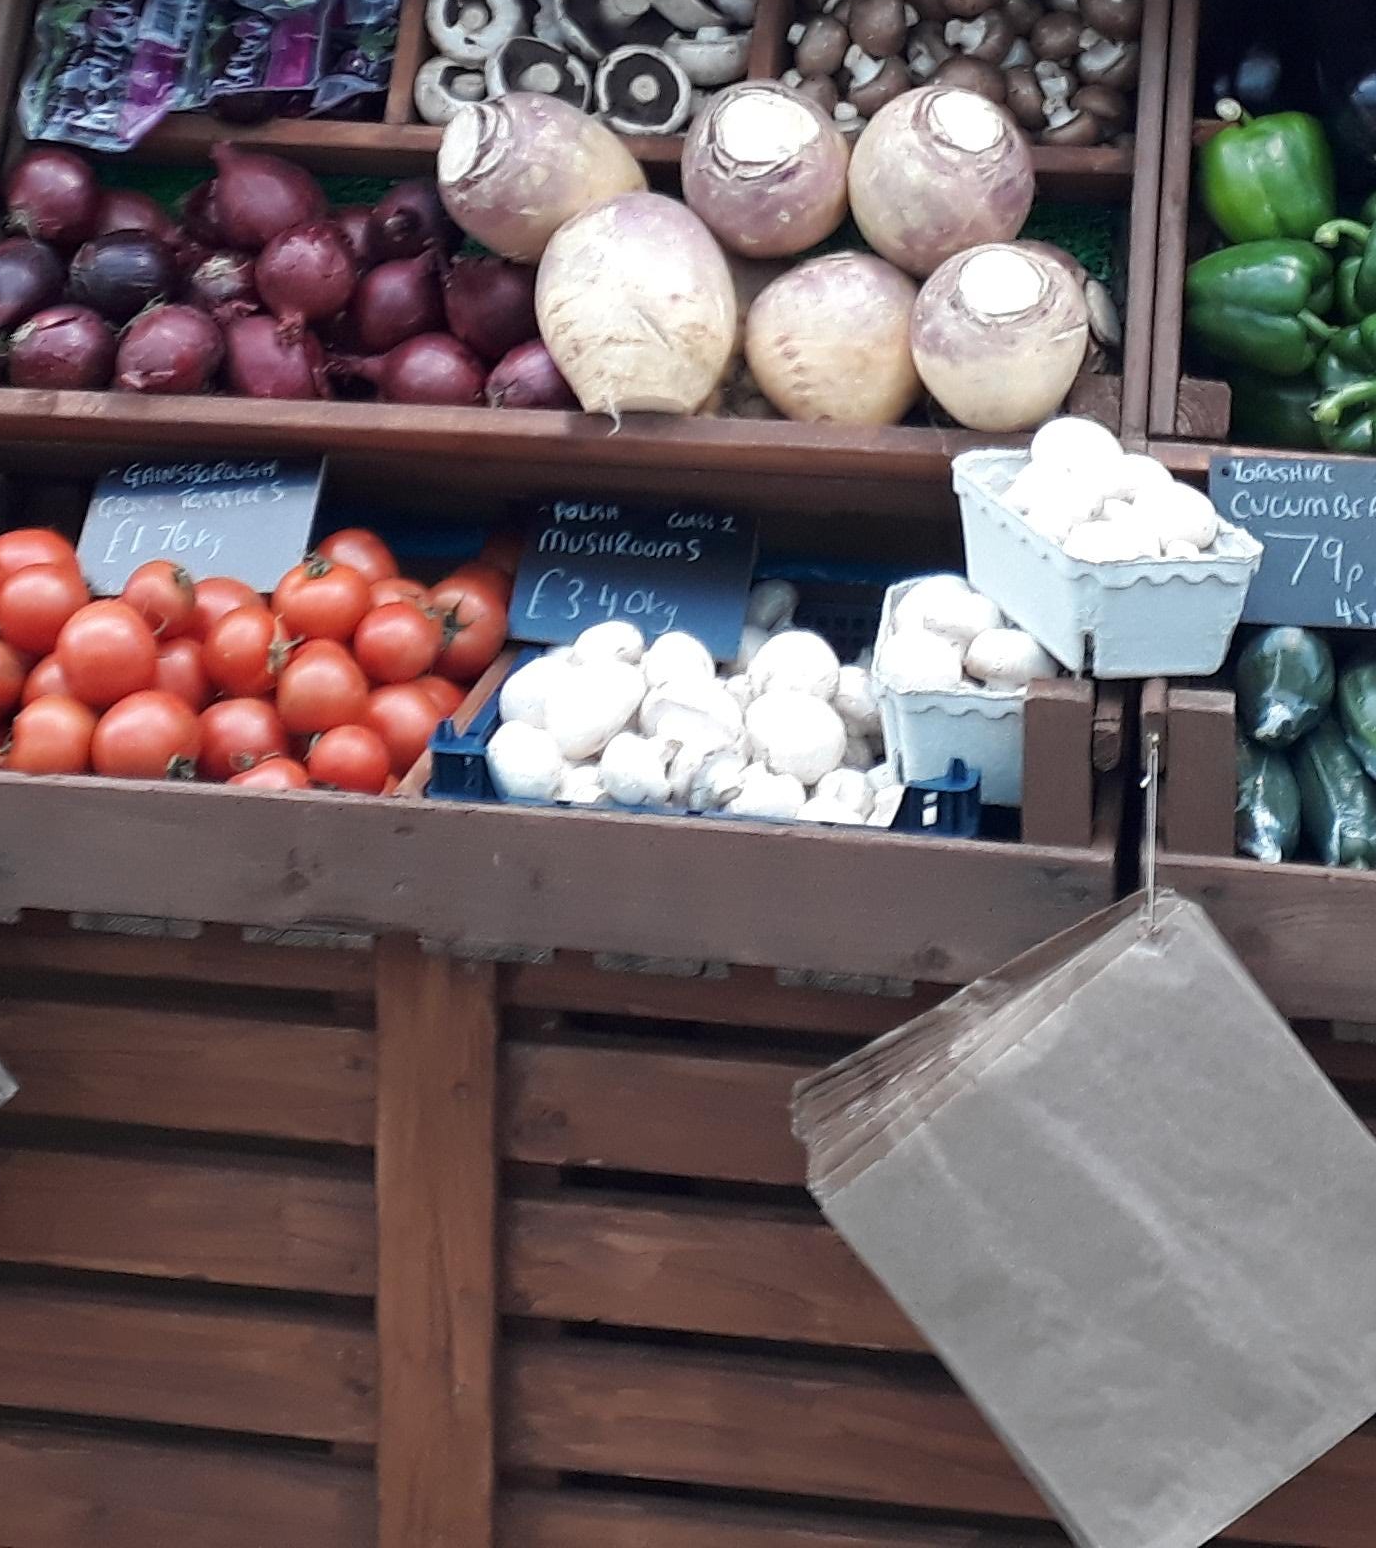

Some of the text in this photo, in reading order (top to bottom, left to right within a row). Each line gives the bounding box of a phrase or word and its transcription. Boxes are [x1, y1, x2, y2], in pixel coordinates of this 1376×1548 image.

[122, 459, 279, 489] GAINSBOROUGH
[553, 501, 620, 524] POLISH
[538, 528, 703, 562] MUSHROOMS
